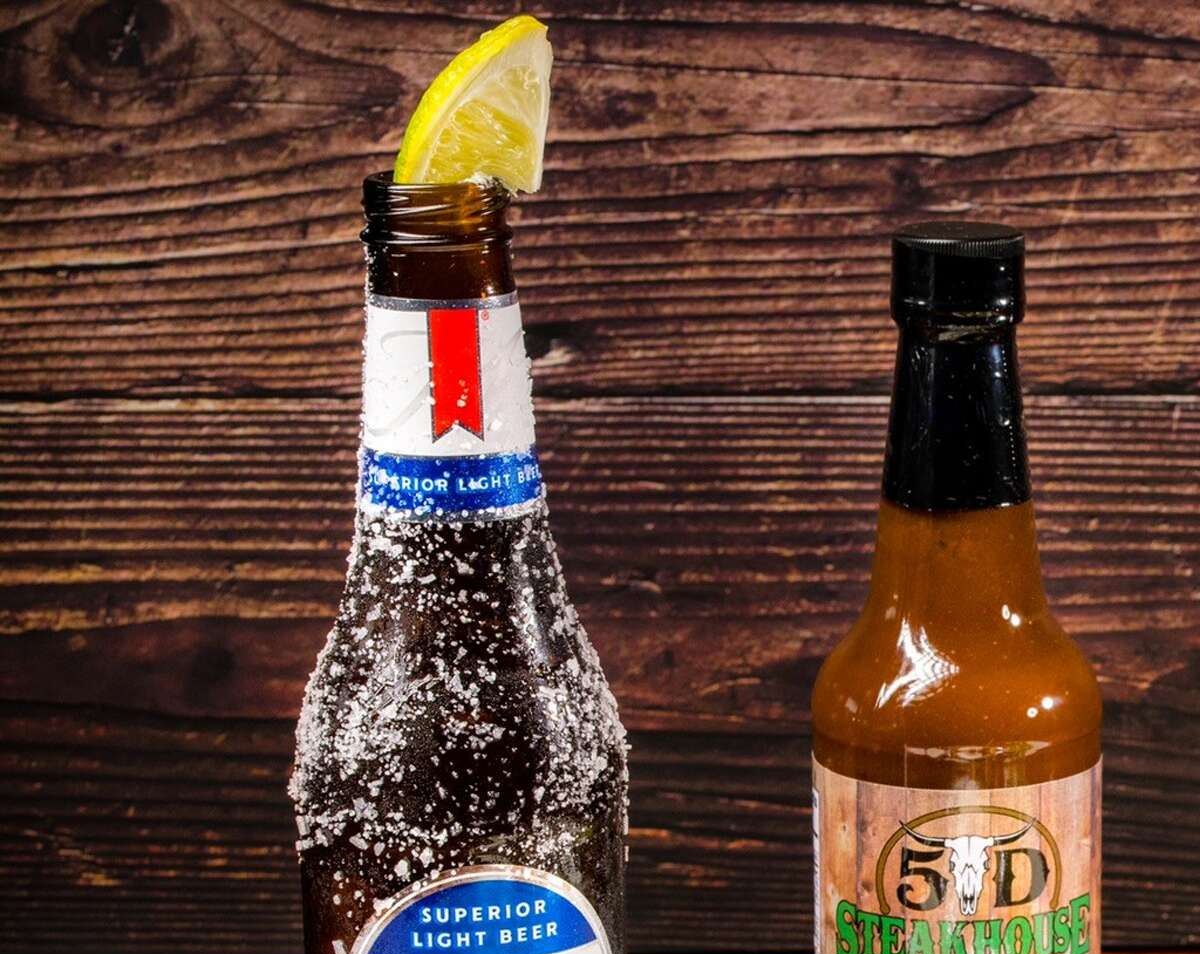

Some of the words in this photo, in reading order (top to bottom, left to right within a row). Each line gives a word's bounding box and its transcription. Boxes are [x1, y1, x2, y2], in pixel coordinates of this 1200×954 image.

[896, 847, 949, 911] 5
[994, 848, 1050, 908] D
[421, 899, 547, 923] SUPERIOR
[412, 930, 487, 948] LIGHT
[499, 922, 559, 945] BEER
